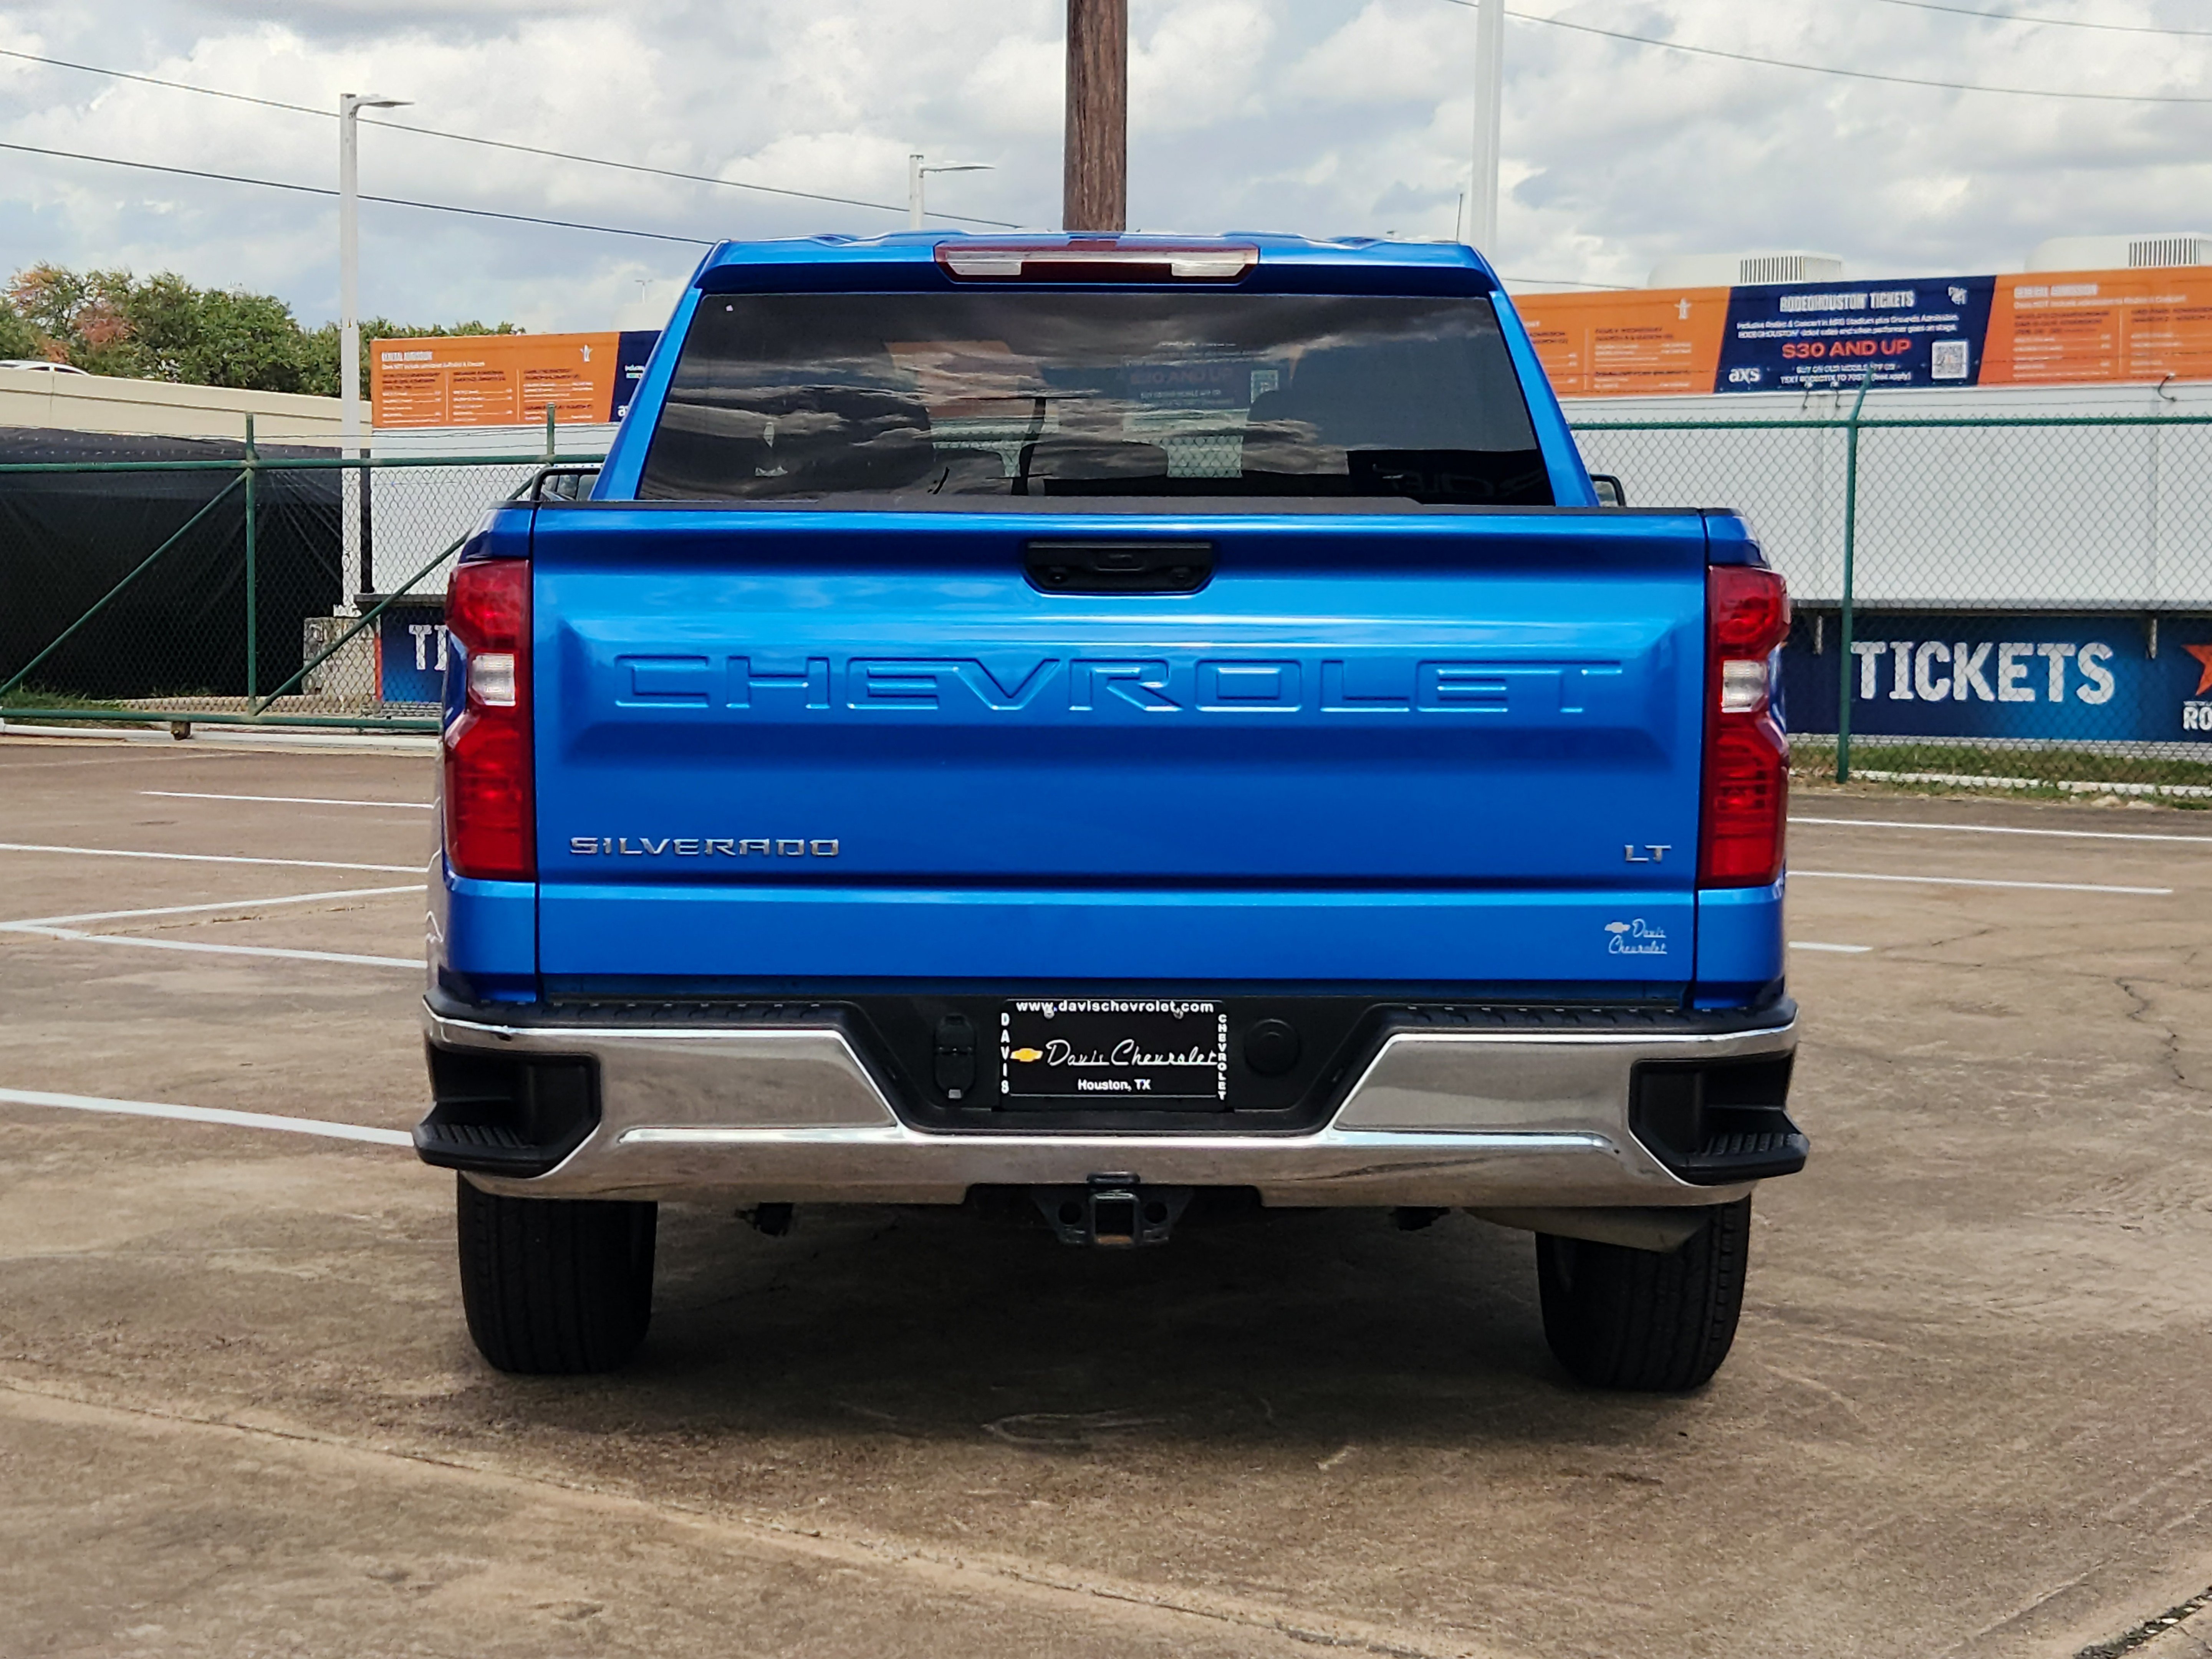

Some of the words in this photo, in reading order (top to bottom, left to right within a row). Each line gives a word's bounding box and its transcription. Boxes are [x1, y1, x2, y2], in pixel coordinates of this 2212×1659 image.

[1869, 291, 1914, 309] TICKETS
[1829, 341, 1877, 357] AND
[1881, 339, 1911, 355] UP
[1729, 367, 1761, 383] axs
[1850, 642, 2115, 704] TICKETS
[615, 656, 1623, 712] CHEVROLET
[570, 837, 839, 856] SILVERADO
[1624, 845, 1672, 862] LT
[1632, 918, 1666, 937] Davis
[1609, 934, 1667, 954] Chevrolet
[1017, 1000, 1214, 1013] www.davischevrolet.com
[1001, 1013, 1010, 1094] DAVIS
[1045, 1039, 1110, 1066] Davis
[1111, 1039, 1218, 1066] Chevrolet
[1218, 1014, 1227, 1100] CHEVROLET
[1078, 1079, 1132, 1092] Houston,
[1134, 1079, 1151, 1090] TX
